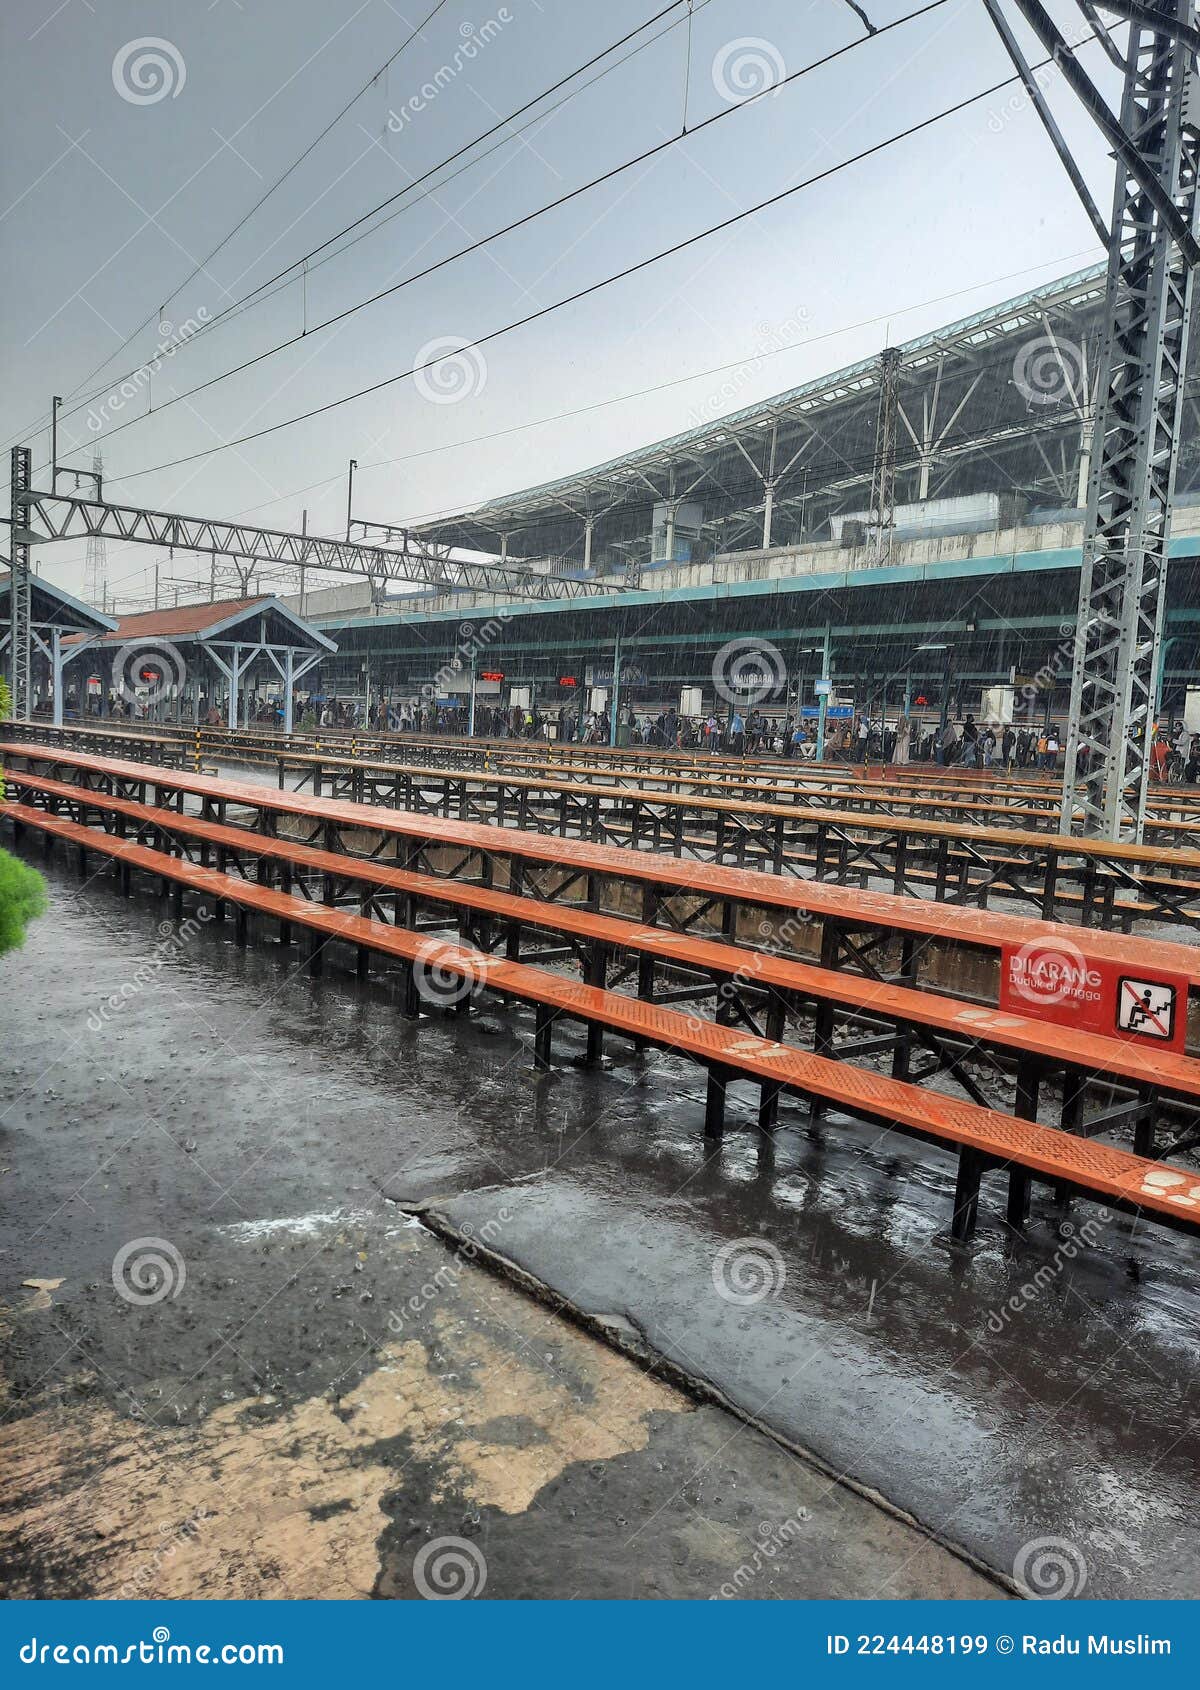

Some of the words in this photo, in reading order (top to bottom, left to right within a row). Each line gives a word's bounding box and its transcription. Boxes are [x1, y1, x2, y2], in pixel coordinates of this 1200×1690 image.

[1009, 974, 1043, 988] Duduk
[1046, 982, 1056, 991] di
[1010, 956, 1102, 987] DILARANG
